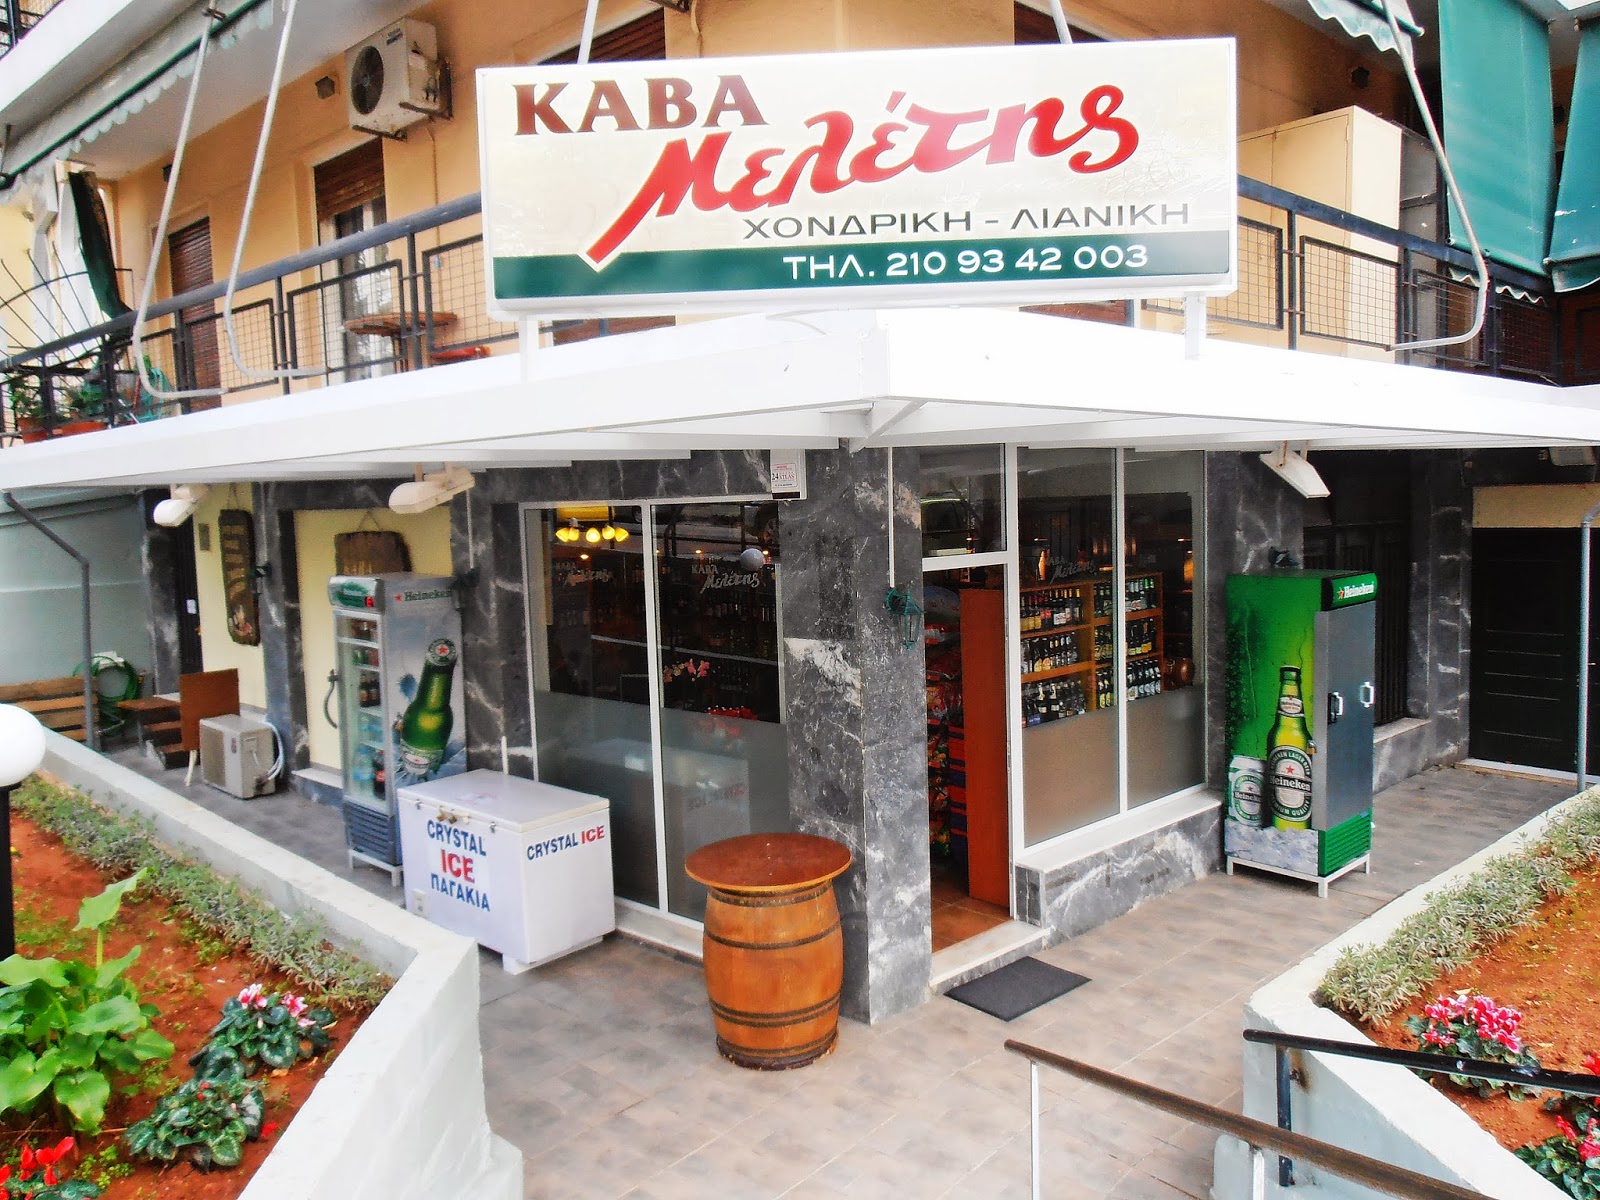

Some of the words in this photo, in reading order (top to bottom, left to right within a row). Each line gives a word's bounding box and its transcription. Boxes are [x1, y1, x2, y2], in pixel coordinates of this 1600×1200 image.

[513, 75, 769, 135] ΚΑΒΑ
[585, 84, 1140, 264] Μελέτης
[742, 210, 972, 240] ΧΟΝΔΡΙΚΗ
[1010, 202, 1190, 231] ΛΙΑΝΙΚΗ
[783, 255, 875, 280] ΤΗΛ.
[886, 251, 947, 277] 210
[957, 248, 1005, 275] 93
[1015, 247, 1063, 273] 42
[1073, 244, 1149, 270] 003
[1343, 581, 1375, 599] Heineken
[427, 819, 487, 856] CRYSTAL
[526, 832, 579, 861] CRYSTAL
[581, 825, 605, 844] ICE
[441, 848, 475, 884] ICE
[431, 872, 490, 912] ΠΑΓΑΚΙΑ
